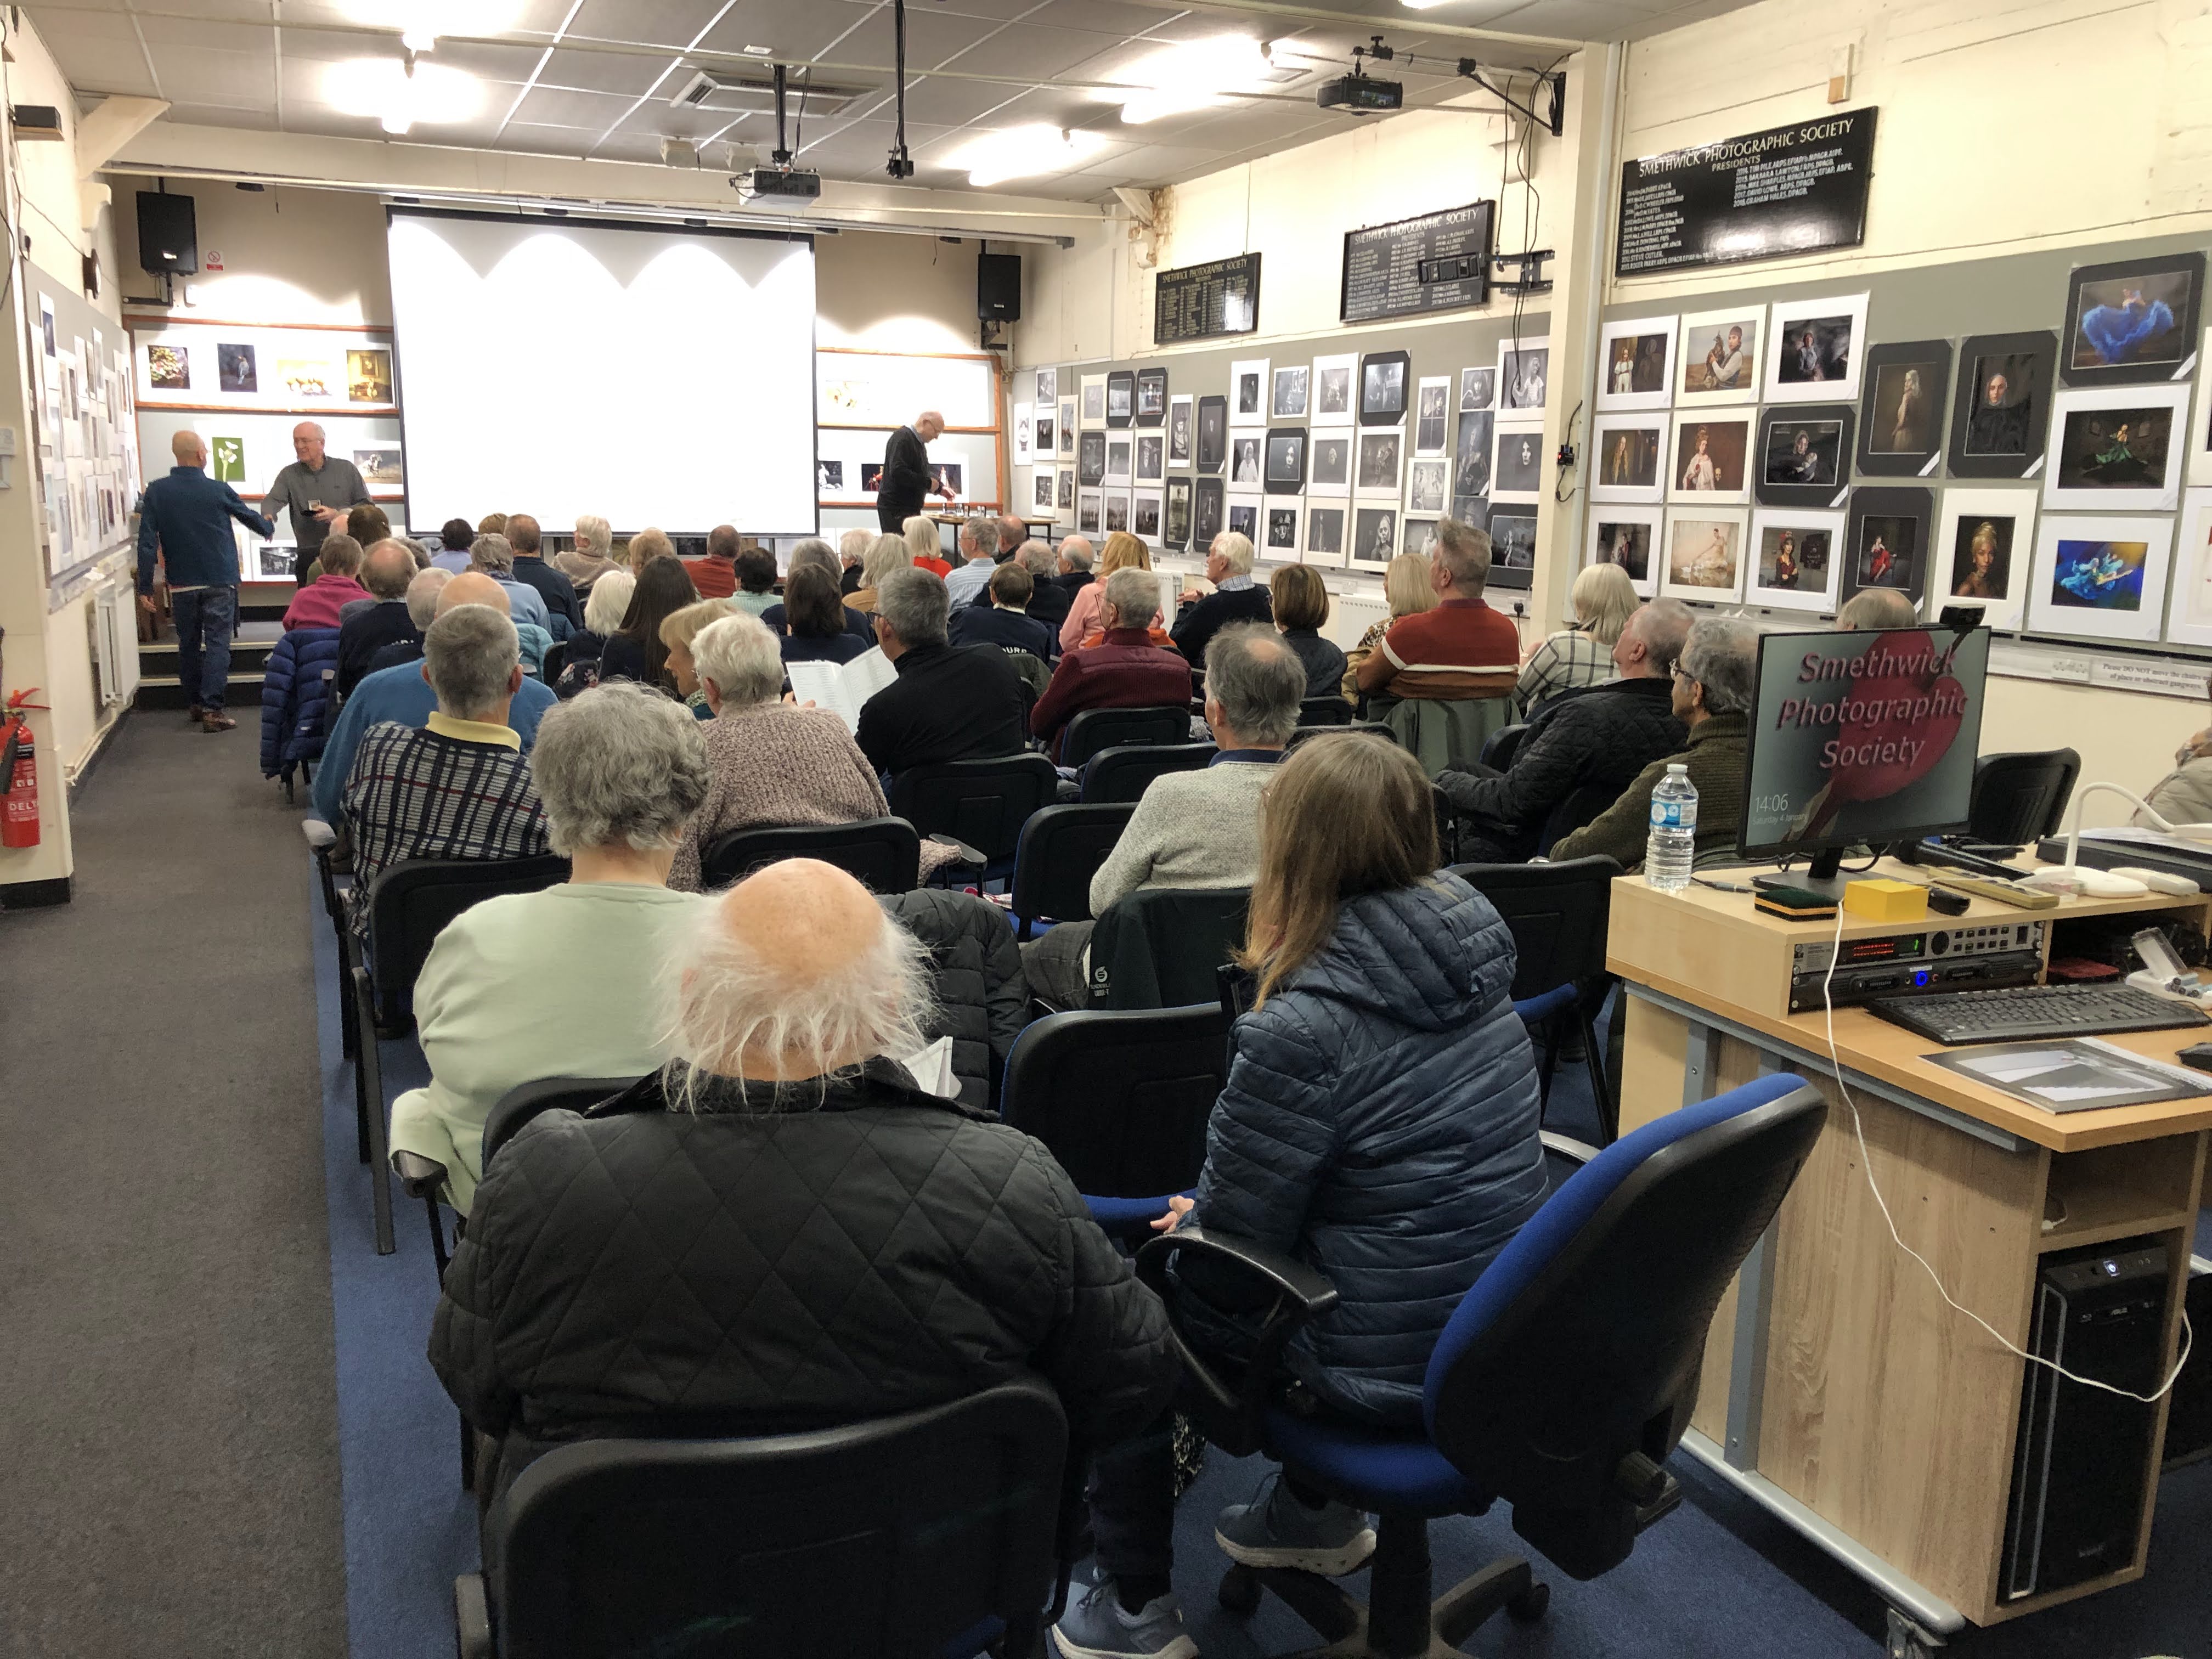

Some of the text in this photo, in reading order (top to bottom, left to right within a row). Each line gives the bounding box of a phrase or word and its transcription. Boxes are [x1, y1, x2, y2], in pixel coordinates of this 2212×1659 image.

[1639, 119, 1854, 178] SMETHWICK PHOTOGRAPHIC SOCIETY
[1712, 154, 1760, 172] PRESIDENTS
[1355, 208, 1479, 245] SMETHWICK PHOTOGRAPHIC SOCIETY
[1189, 263, 1224, 278] PHOTOGRAPHIC
[1227, 258, 1248, 270] SOCIETY
[1798, 645, 1955, 682] Smethwick
[1776, 687, 1968, 730] Photographic
[1820, 736, 1925, 769] Society
[1755, 793, 1788, 812] 14:06
